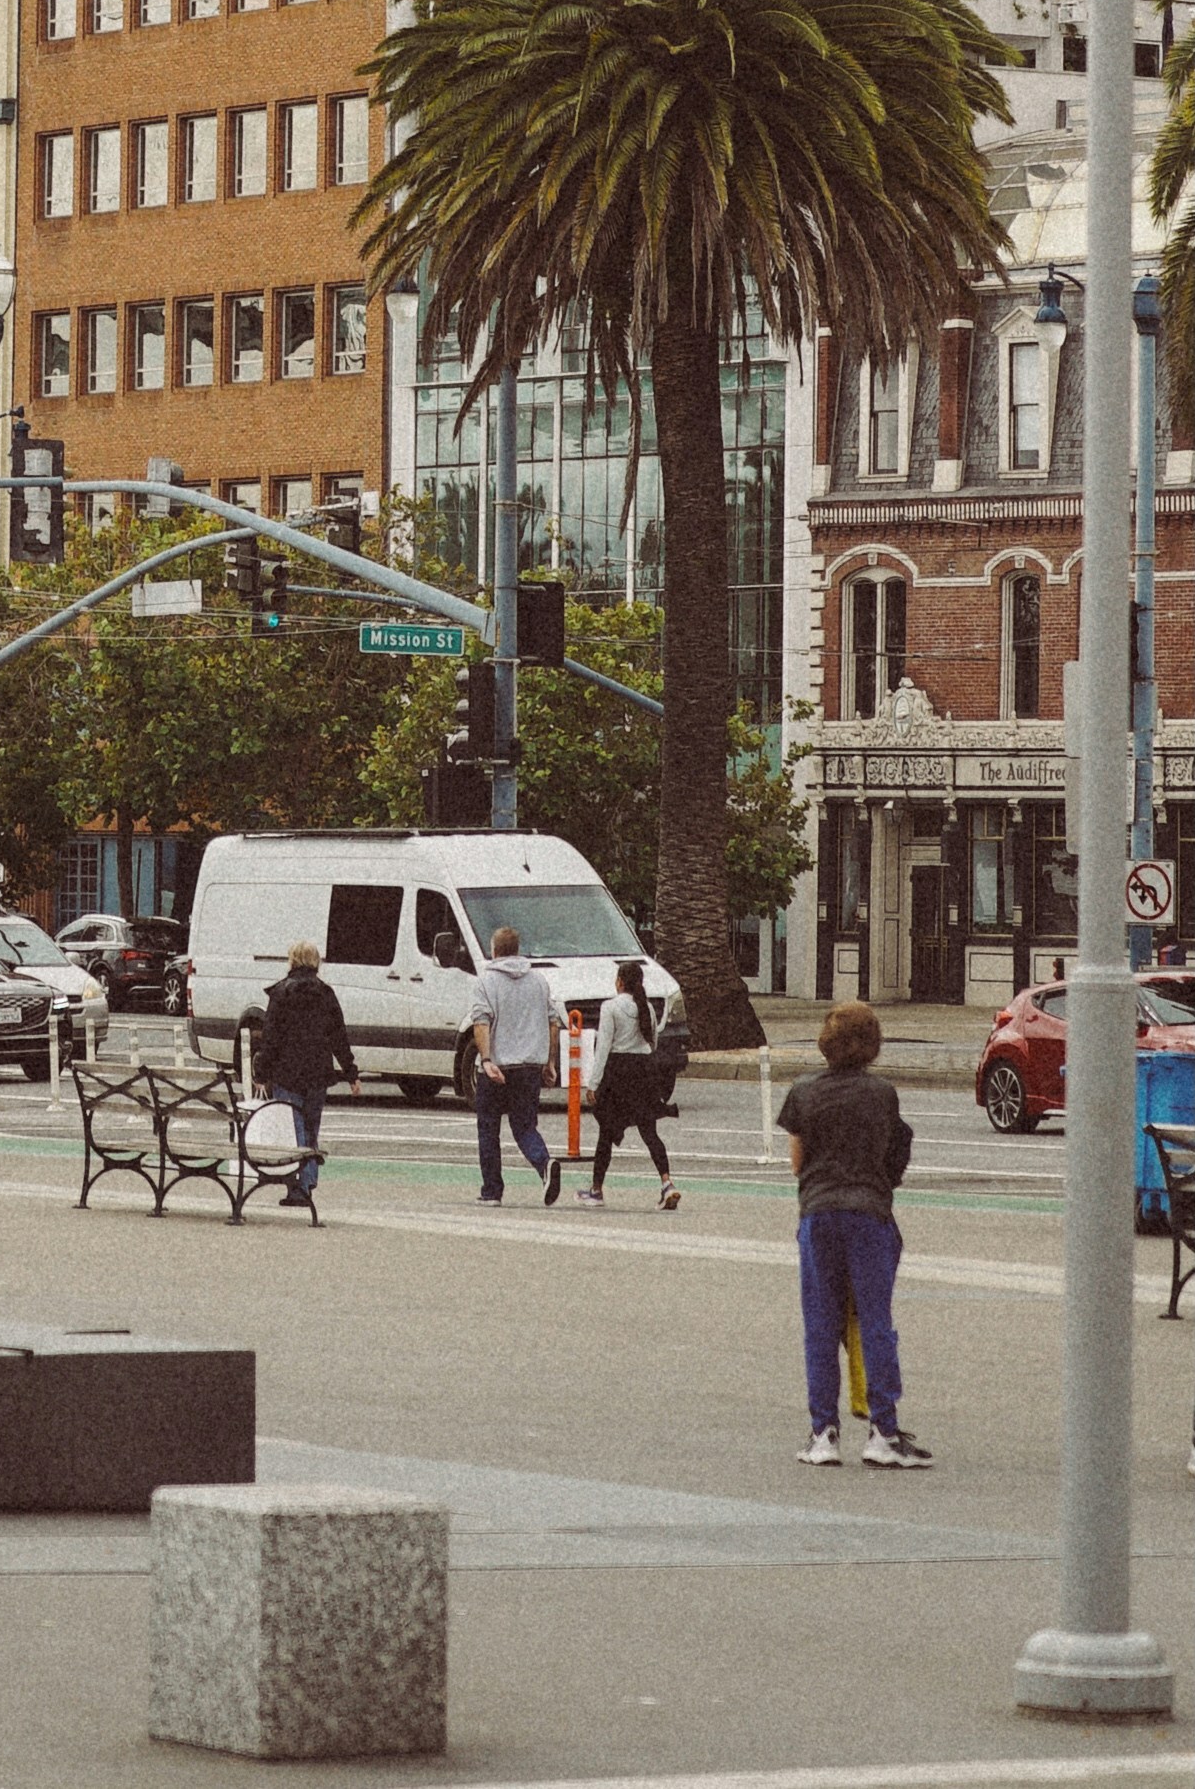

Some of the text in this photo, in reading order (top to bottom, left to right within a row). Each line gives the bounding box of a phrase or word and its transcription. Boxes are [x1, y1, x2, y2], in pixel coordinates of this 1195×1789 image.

[370, 630, 454, 648] Mission St
[980, 760, 1002, 784] The
